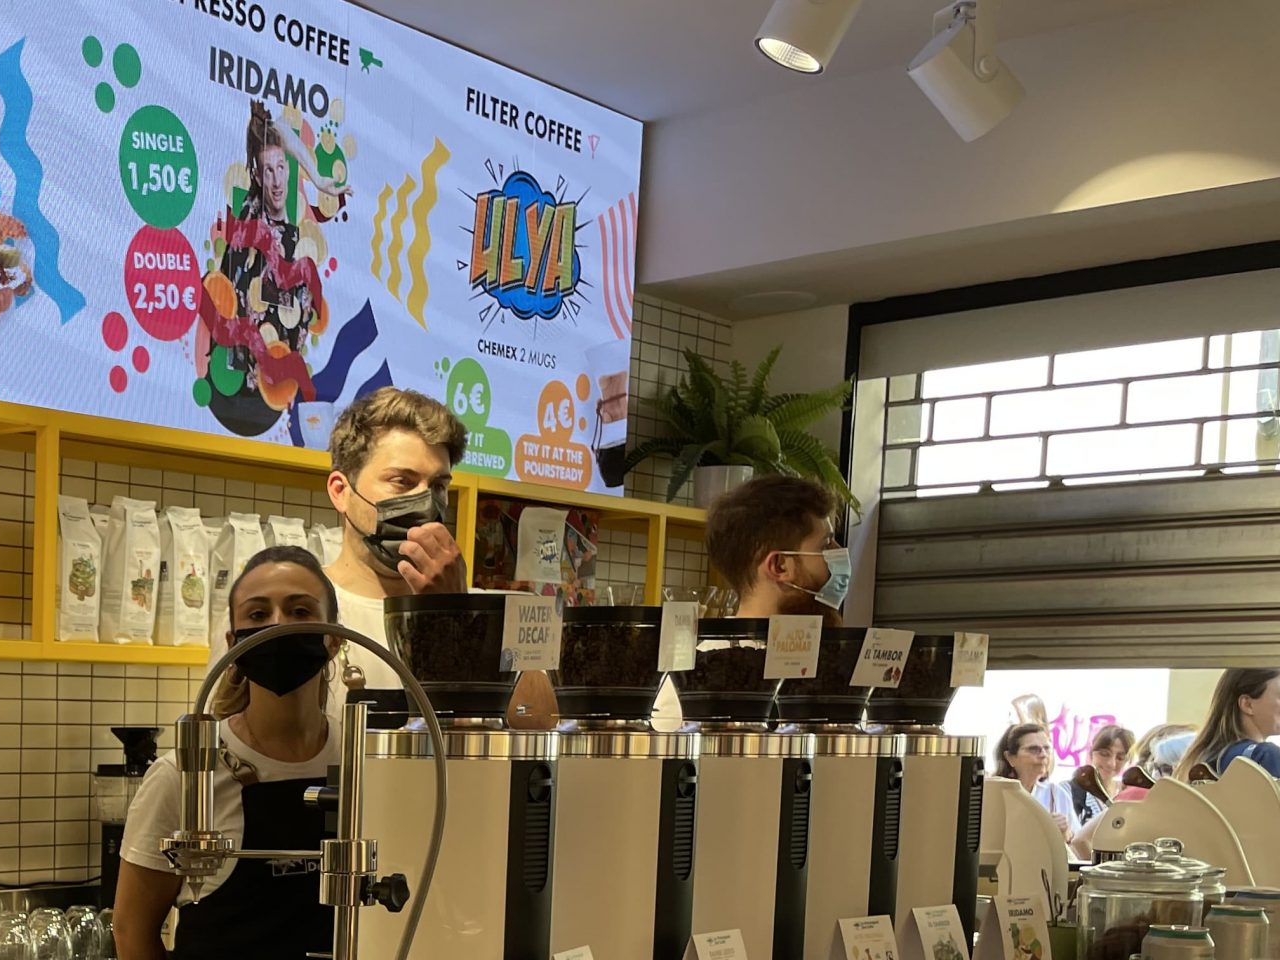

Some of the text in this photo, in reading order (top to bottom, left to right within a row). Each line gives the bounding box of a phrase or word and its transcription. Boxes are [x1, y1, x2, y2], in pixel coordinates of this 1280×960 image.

[274, 14, 350, 65] COFFEE
[209, 46, 329, 118] IRIDAMO
[466, 87, 581, 152] FILTER COFFEE
[132, 132, 184, 153] SINGLE
[128, 162, 192, 196] 1,50€
[134, 252, 191, 271] DOUBLE
[134, 283, 196, 313] 2,50€
[478, 339, 557, 369] CHEMEX 2 MUGS
[453, 382, 486, 416] 6€
[544, 399, 573, 432] 4€
[523, 441, 583, 465] TRY IT AT THE
[524, 461, 583, 483] POURSTEADY
[518, 605, 553, 623] WATER
[518, 622, 550, 643] DECAF
[872, 649, 903, 661] TAMBOR
